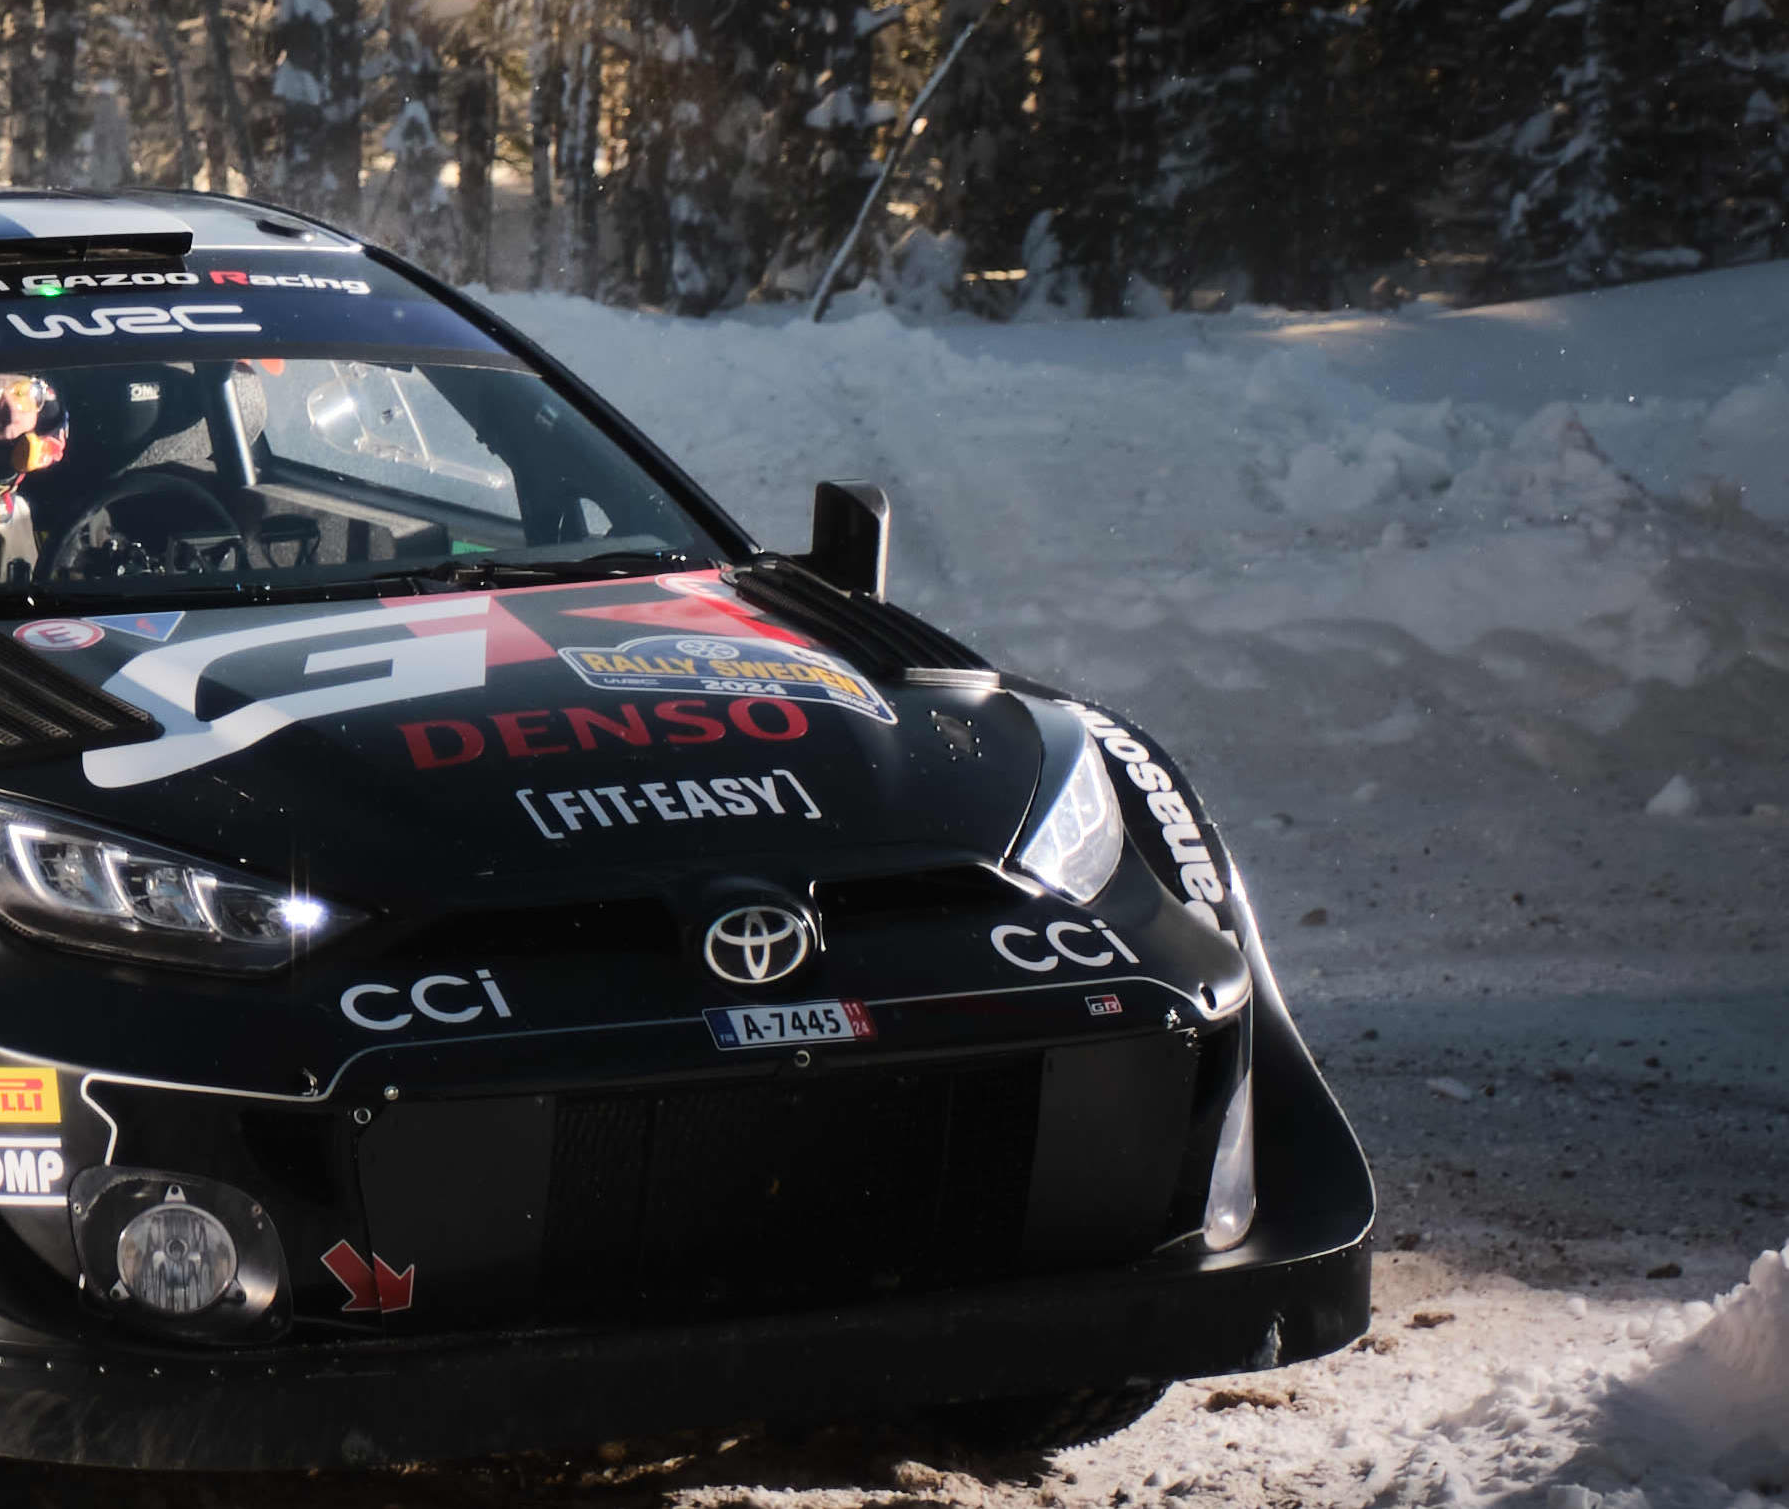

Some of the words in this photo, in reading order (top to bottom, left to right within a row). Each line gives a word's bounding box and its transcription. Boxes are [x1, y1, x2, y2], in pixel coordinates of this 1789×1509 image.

[23, 272, 200, 296] GAZOO
[209, 270, 371, 294] Racing
[6, 305, 262, 339] WRC
[37, 625, 86, 645] E
[581, 652, 697, 676] RALLY
[708, 657, 868, 699] SWEDEN
[700, 679, 789, 696] 2024
[397, 694, 810, 770] DENSO
[340, 969, 512, 1032] CCi
[844, 1003, 862, 1017] 11
[1091, 1001, 1119, 1013] GR
[743, 1008, 841, 1041] A-7445
